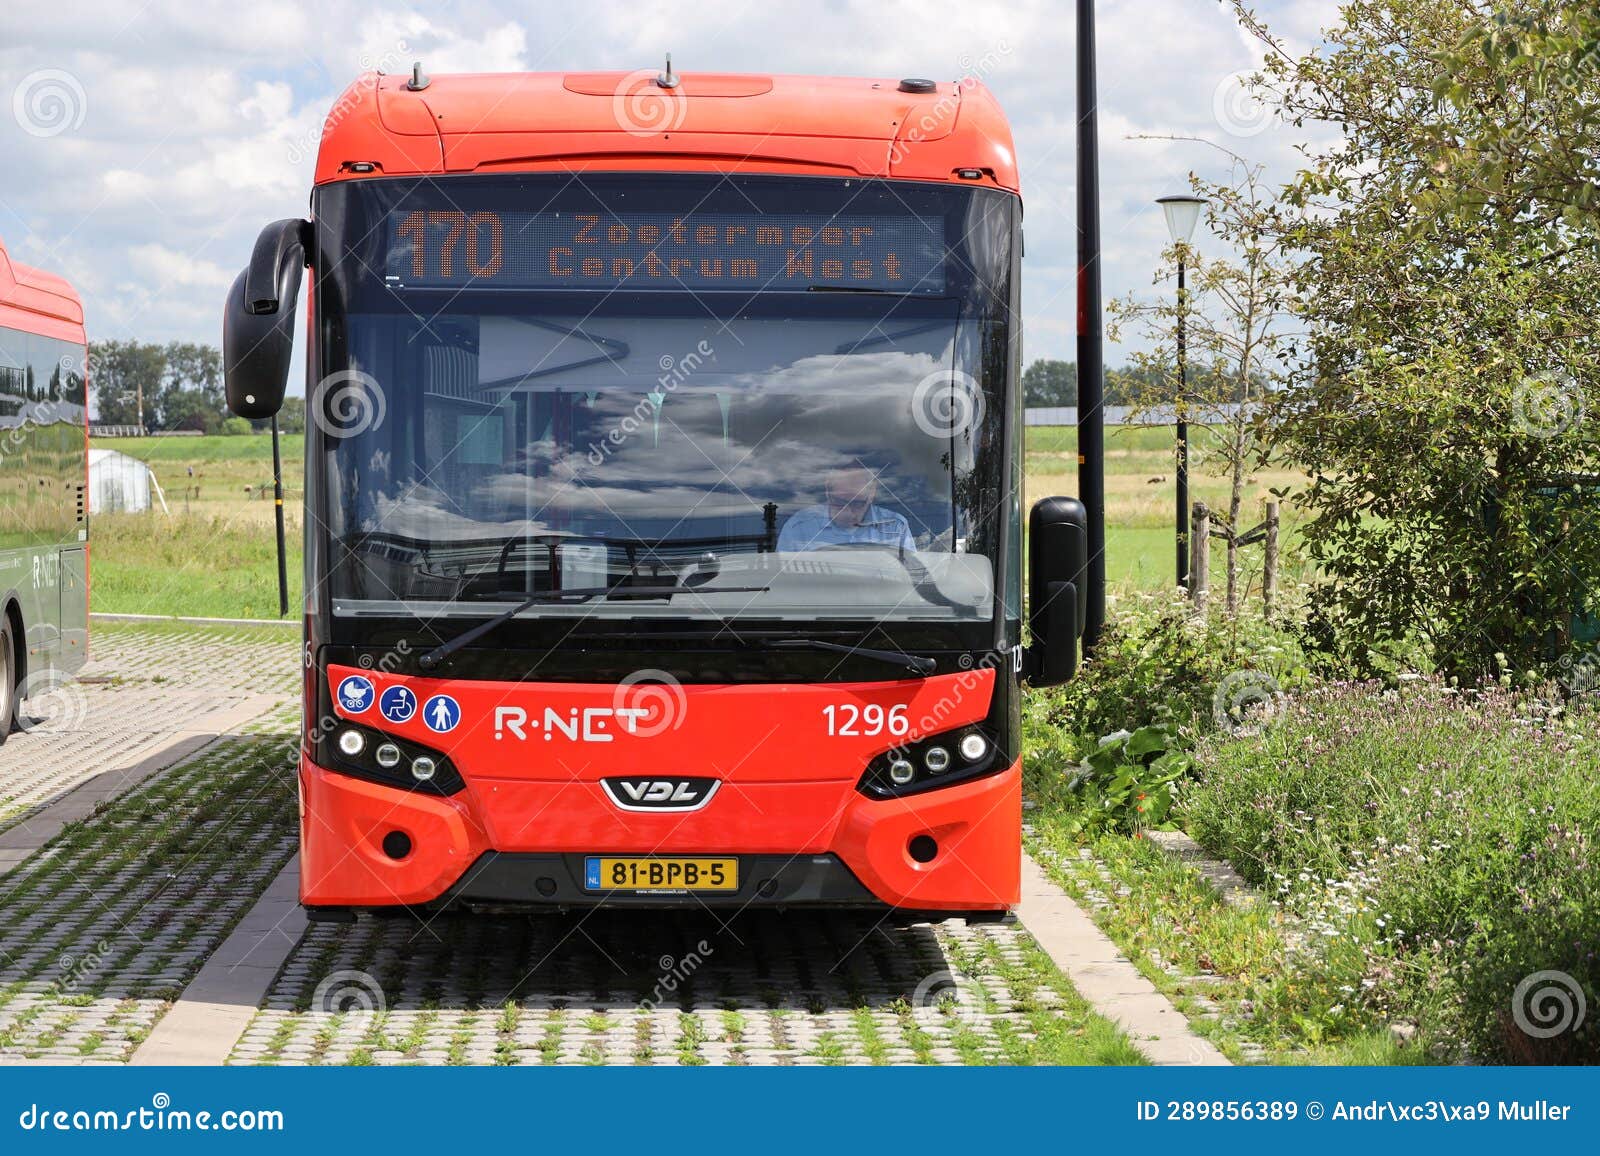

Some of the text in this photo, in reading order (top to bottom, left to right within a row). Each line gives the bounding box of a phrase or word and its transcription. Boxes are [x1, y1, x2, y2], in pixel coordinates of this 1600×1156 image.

[397, 210, 502, 278] 170
[574, 215, 874, 245] Zoetermeer
[548, 247, 902, 280] Centrum West
[822, 704, 909, 736] 1296
[619, 781, 699, 801] VDL
[588, 862, 725, 886] NL 81-BPB-5
